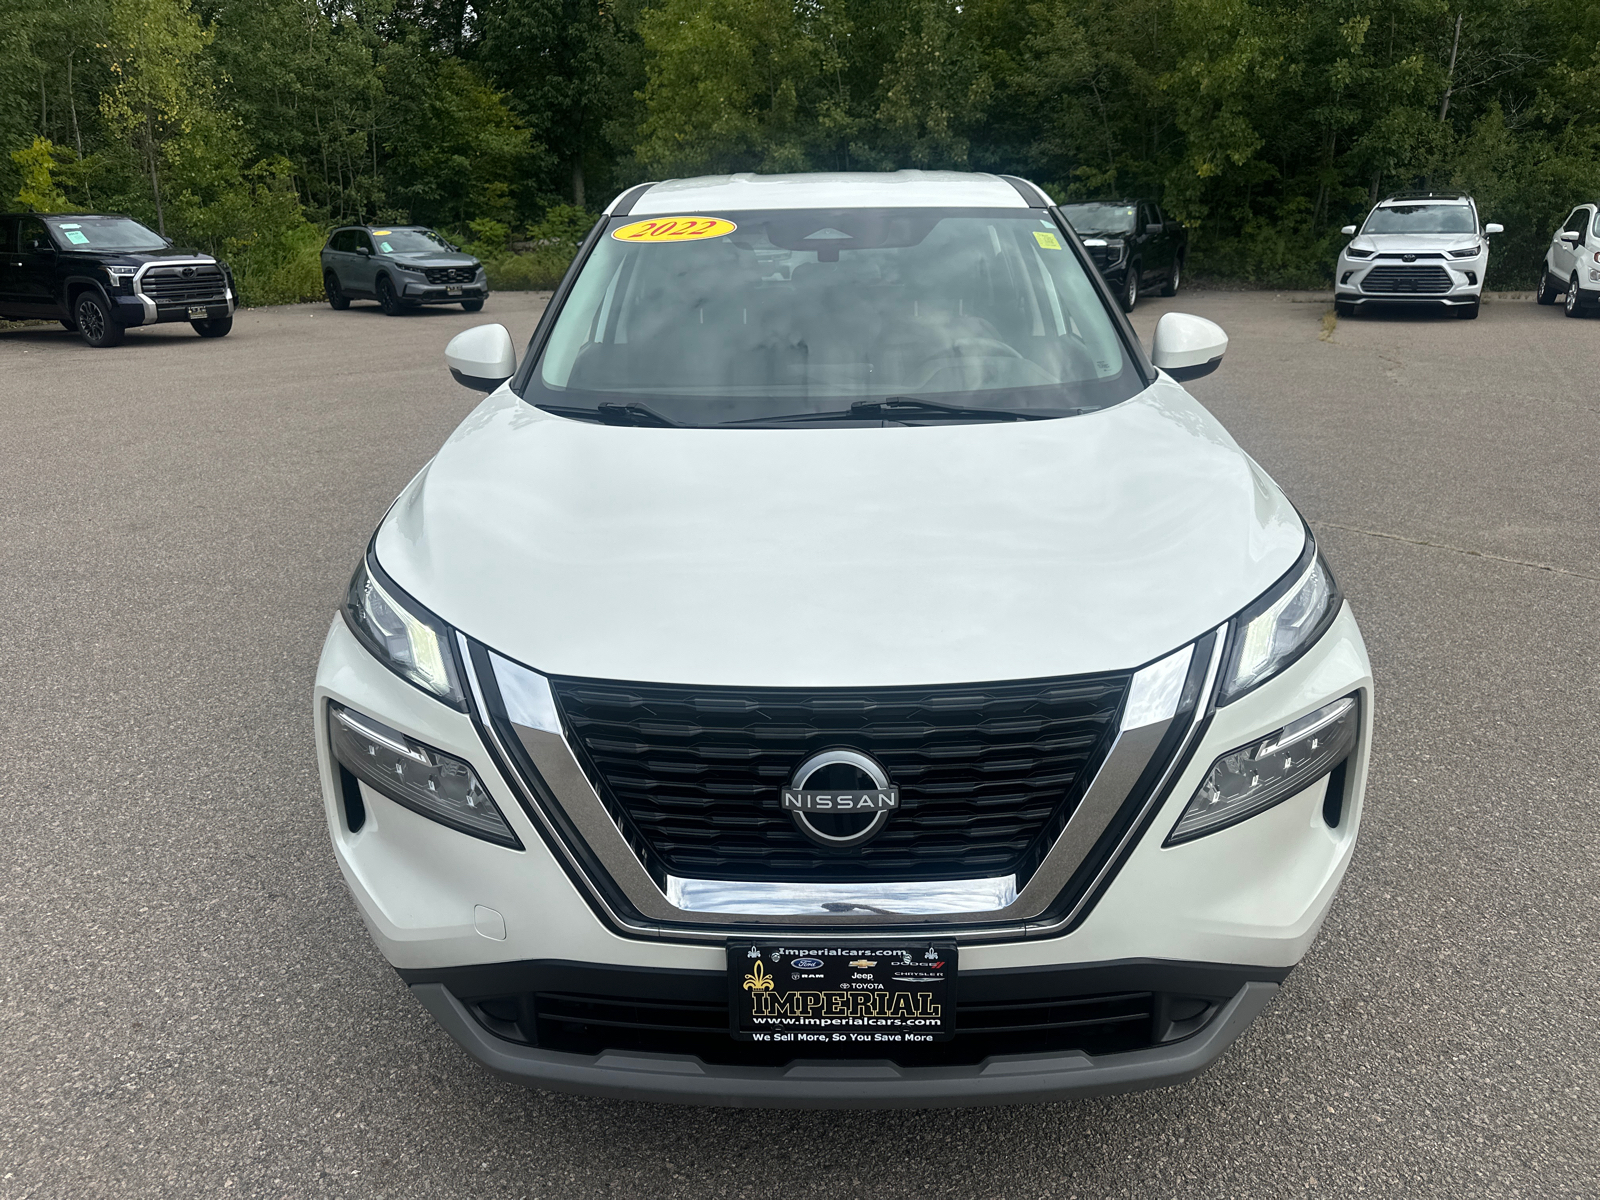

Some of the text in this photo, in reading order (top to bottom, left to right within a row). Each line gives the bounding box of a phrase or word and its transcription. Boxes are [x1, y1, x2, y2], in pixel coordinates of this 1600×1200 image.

[627, 221, 717, 238] 2022
[785, 792, 895, 808] NISSAN
[778, 947, 907, 957] Imperialcars.com
[851, 972, 873, 980] Jeep
[751, 991, 941, 1017] IMPERIAL
[752, 1017, 941, 1026] www.imperialcars.com
[752, 1033, 934, 1042] We Sell More, So You Save More
